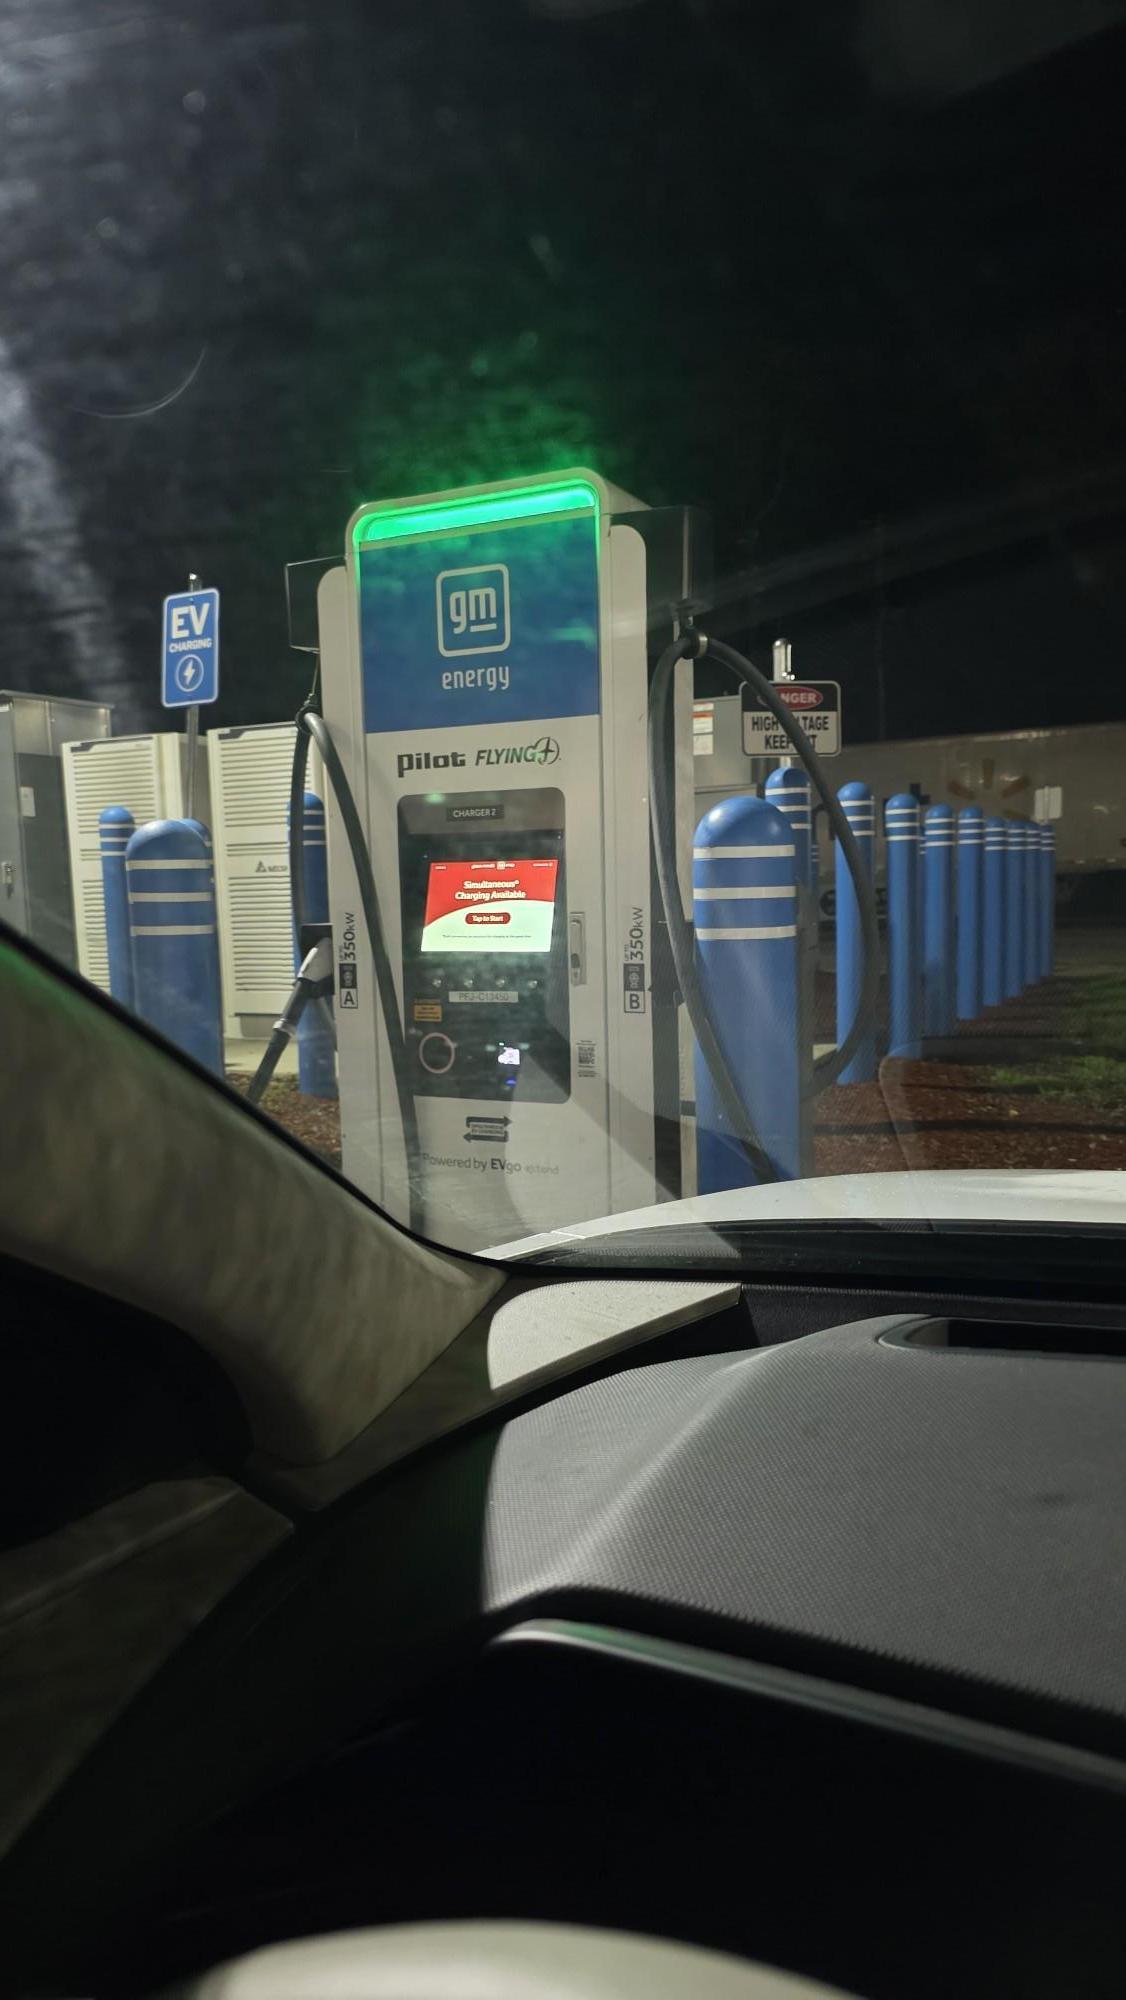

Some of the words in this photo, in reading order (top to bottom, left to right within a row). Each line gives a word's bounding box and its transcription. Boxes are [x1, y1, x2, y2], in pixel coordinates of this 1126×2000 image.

[449, 587, 497, 635] gm
[171, 602, 210, 639] EV
[169, 637, 213, 653] CHARGING
[442, 665, 510, 691] energy
[751, 715, 779, 731] HIGH
[453, 808, 490, 818] CHARGER
[455, 891, 490, 901] Charging
[491, 890, 526, 899] Available
[472, 915, 482, 923] Tap
[344, 912, 356, 961] 350kW
[629, 906, 644, 961] 350kW
[343, 991, 355, 1005] A
[629, 993, 640, 1010] B
[421, 1152, 471, 1169] Powered
[473, 1157, 487, 1172] by
[490, 1158, 522, 1174] EVgo
